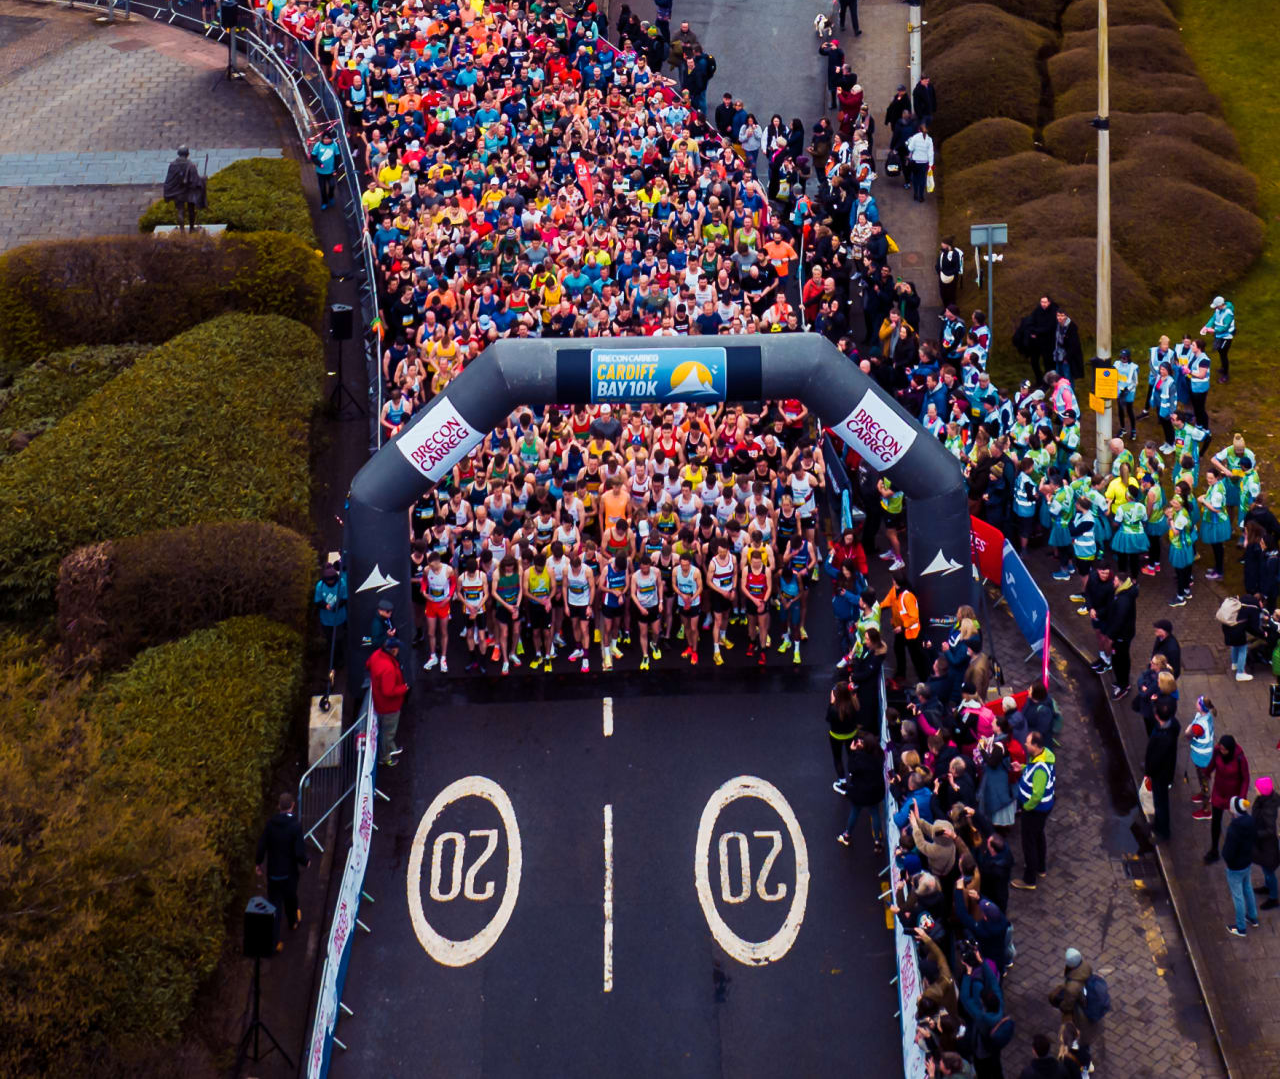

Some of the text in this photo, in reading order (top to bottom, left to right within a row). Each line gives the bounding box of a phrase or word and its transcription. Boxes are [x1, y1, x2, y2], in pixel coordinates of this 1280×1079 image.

[597, 363, 658, 380] CARDIFF
[597, 381, 658, 397] BAY 10K
[411, 416, 461, 464] BRECON
[420, 427, 469, 471] CARREG
[846, 419, 893, 463] CARREG
[854, 408, 903, 456] BRECON
[429, 829, 498, 901] 20
[719, 830, 787, 903] 20
